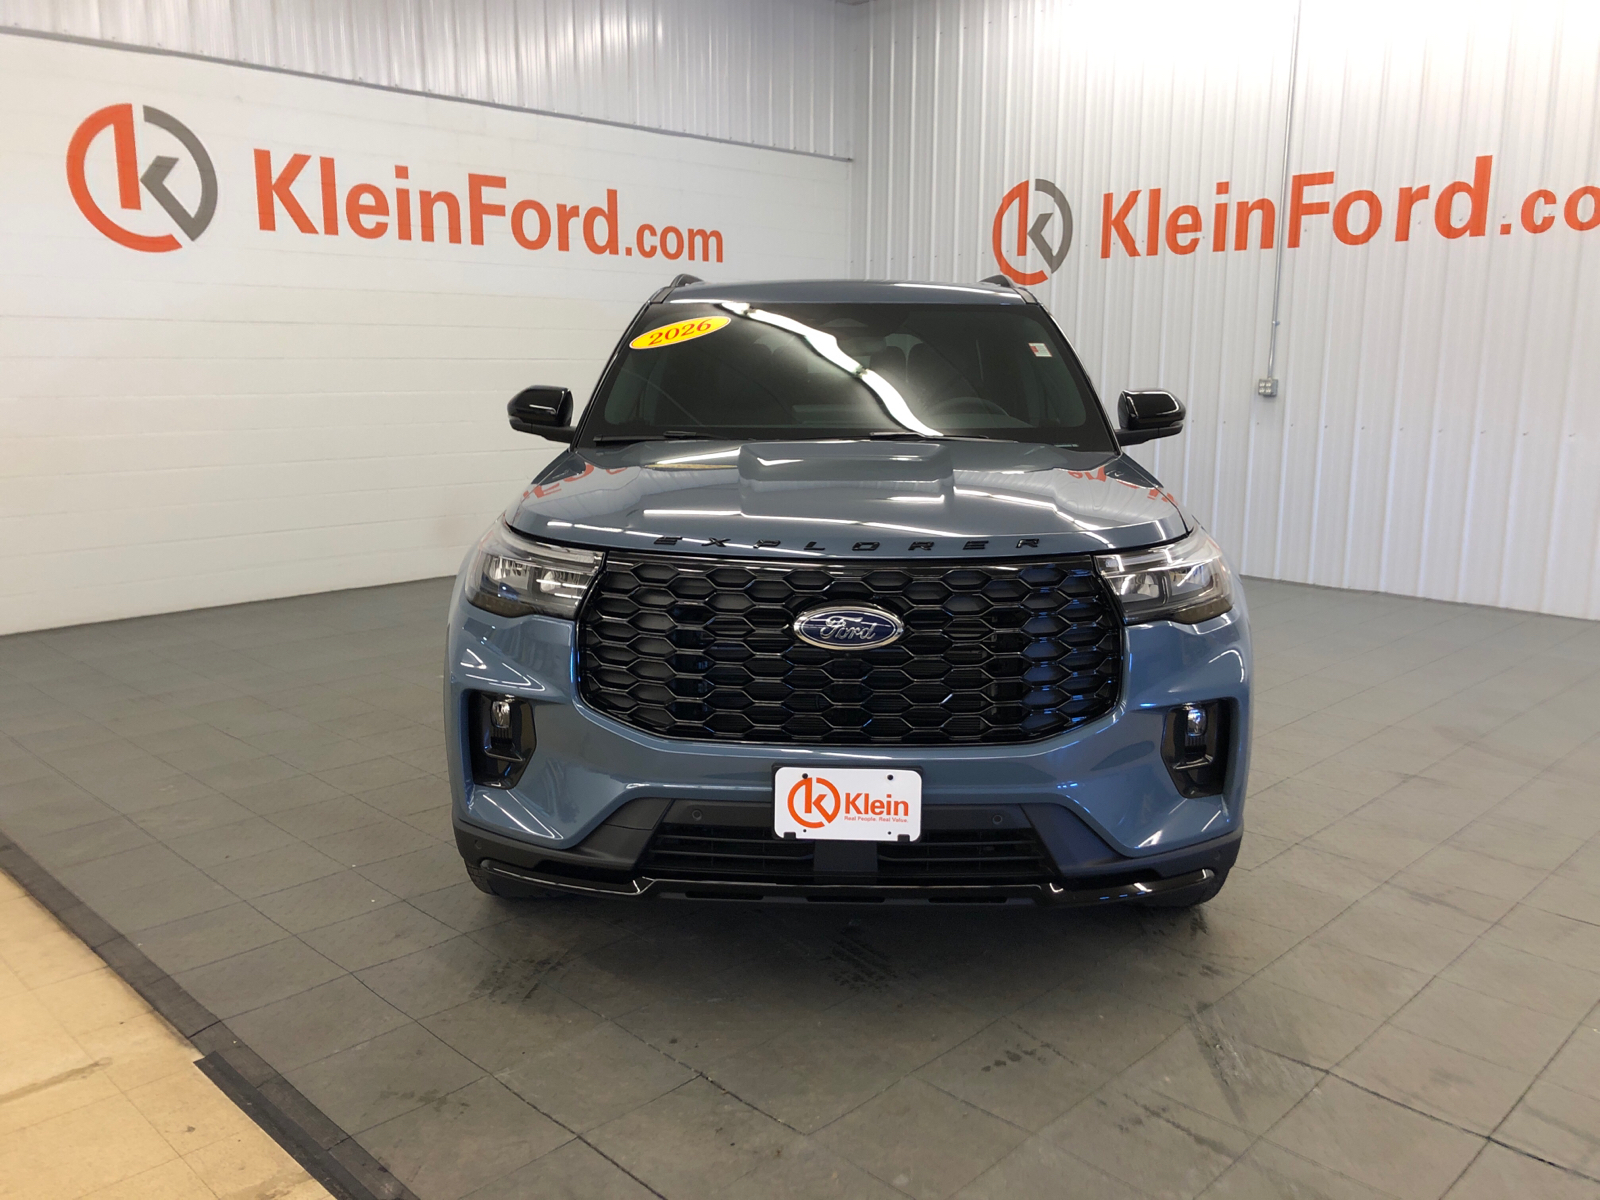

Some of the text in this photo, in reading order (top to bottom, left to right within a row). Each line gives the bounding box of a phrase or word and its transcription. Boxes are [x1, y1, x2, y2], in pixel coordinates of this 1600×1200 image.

[254, 148, 724, 263] KleinFord.com
[648, 318, 712, 346] 2026
[653, 536, 1040, 551] EXPLORER
[820, 615, 877, 640] Ford
[844, 792, 909, 817] Klein
